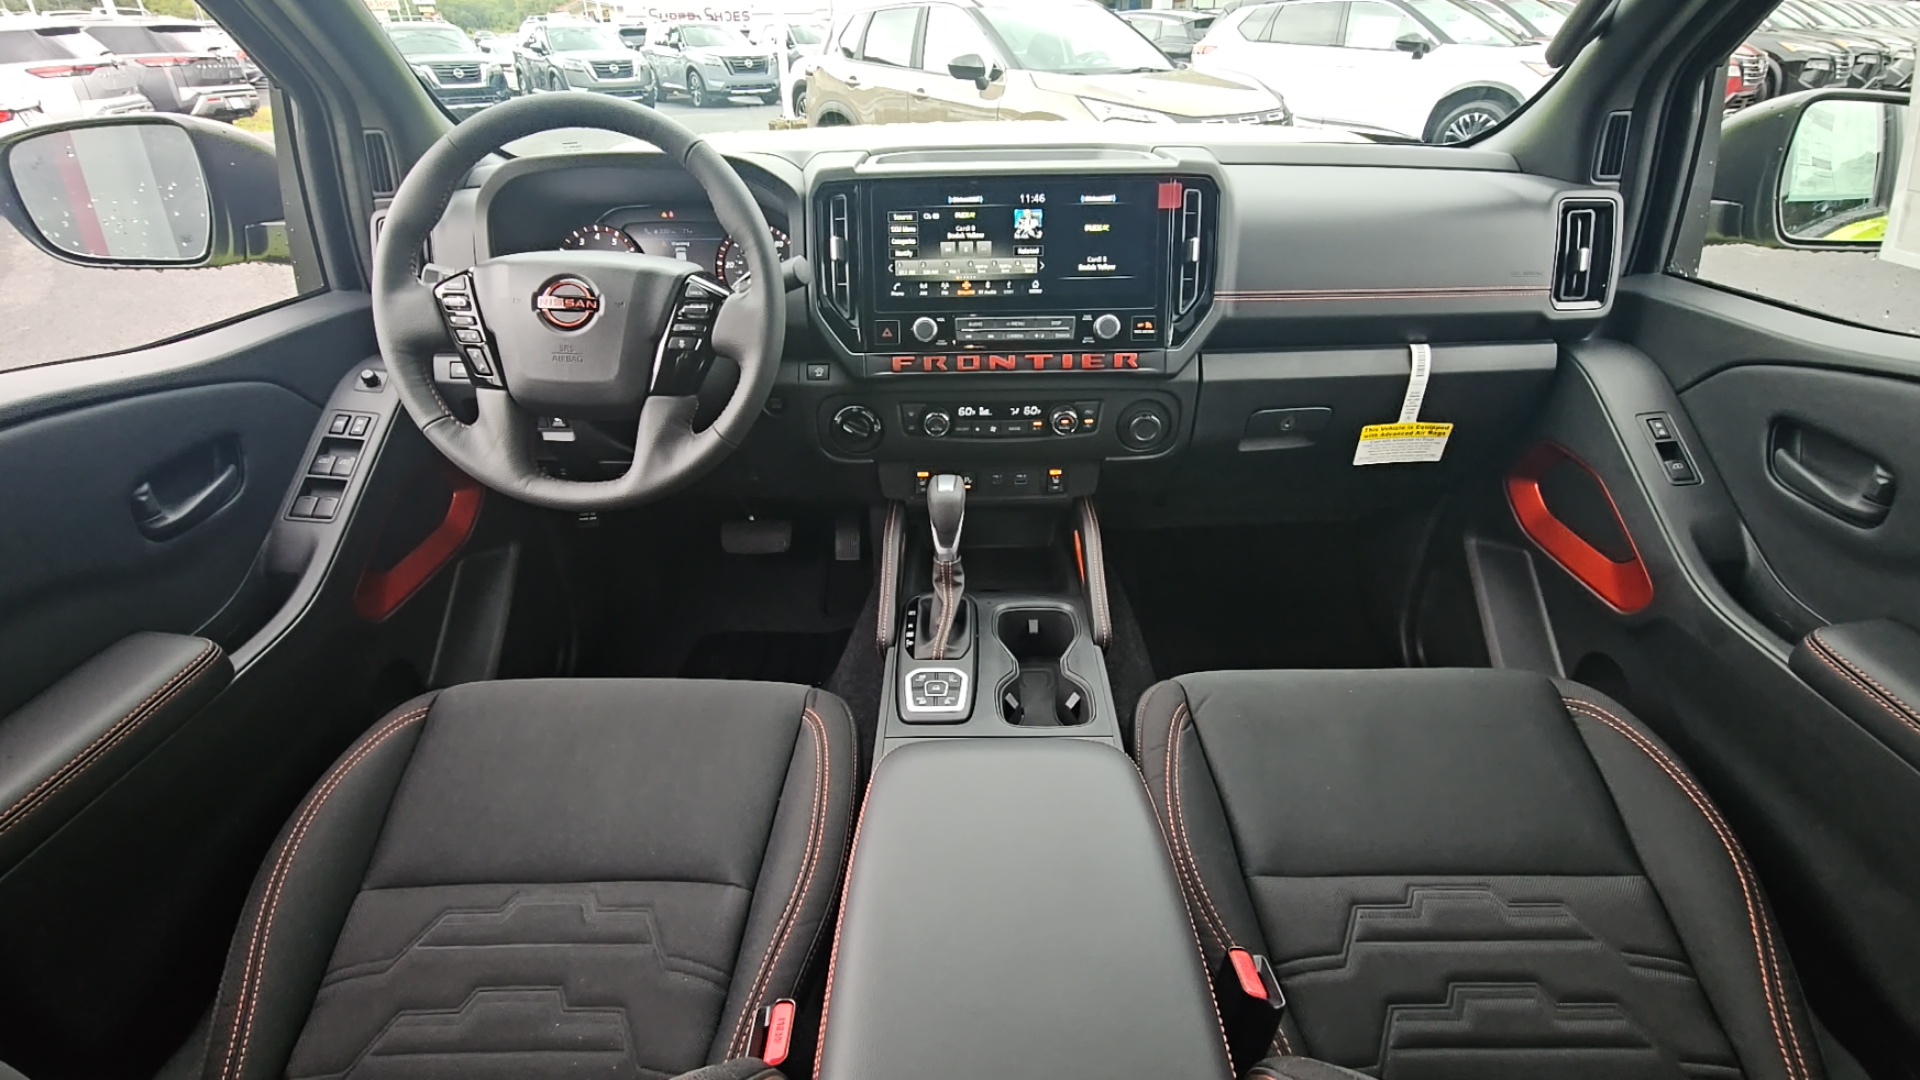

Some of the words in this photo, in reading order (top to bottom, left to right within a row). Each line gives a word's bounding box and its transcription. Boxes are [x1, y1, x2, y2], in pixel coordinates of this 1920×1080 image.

[1020, 193, 1046, 204] 11:46
[538, 296, 597, 309] NISSAN
[552, 355, 583, 363] AIRBAG
[892, 353, 1138, 371] FRONTIER
